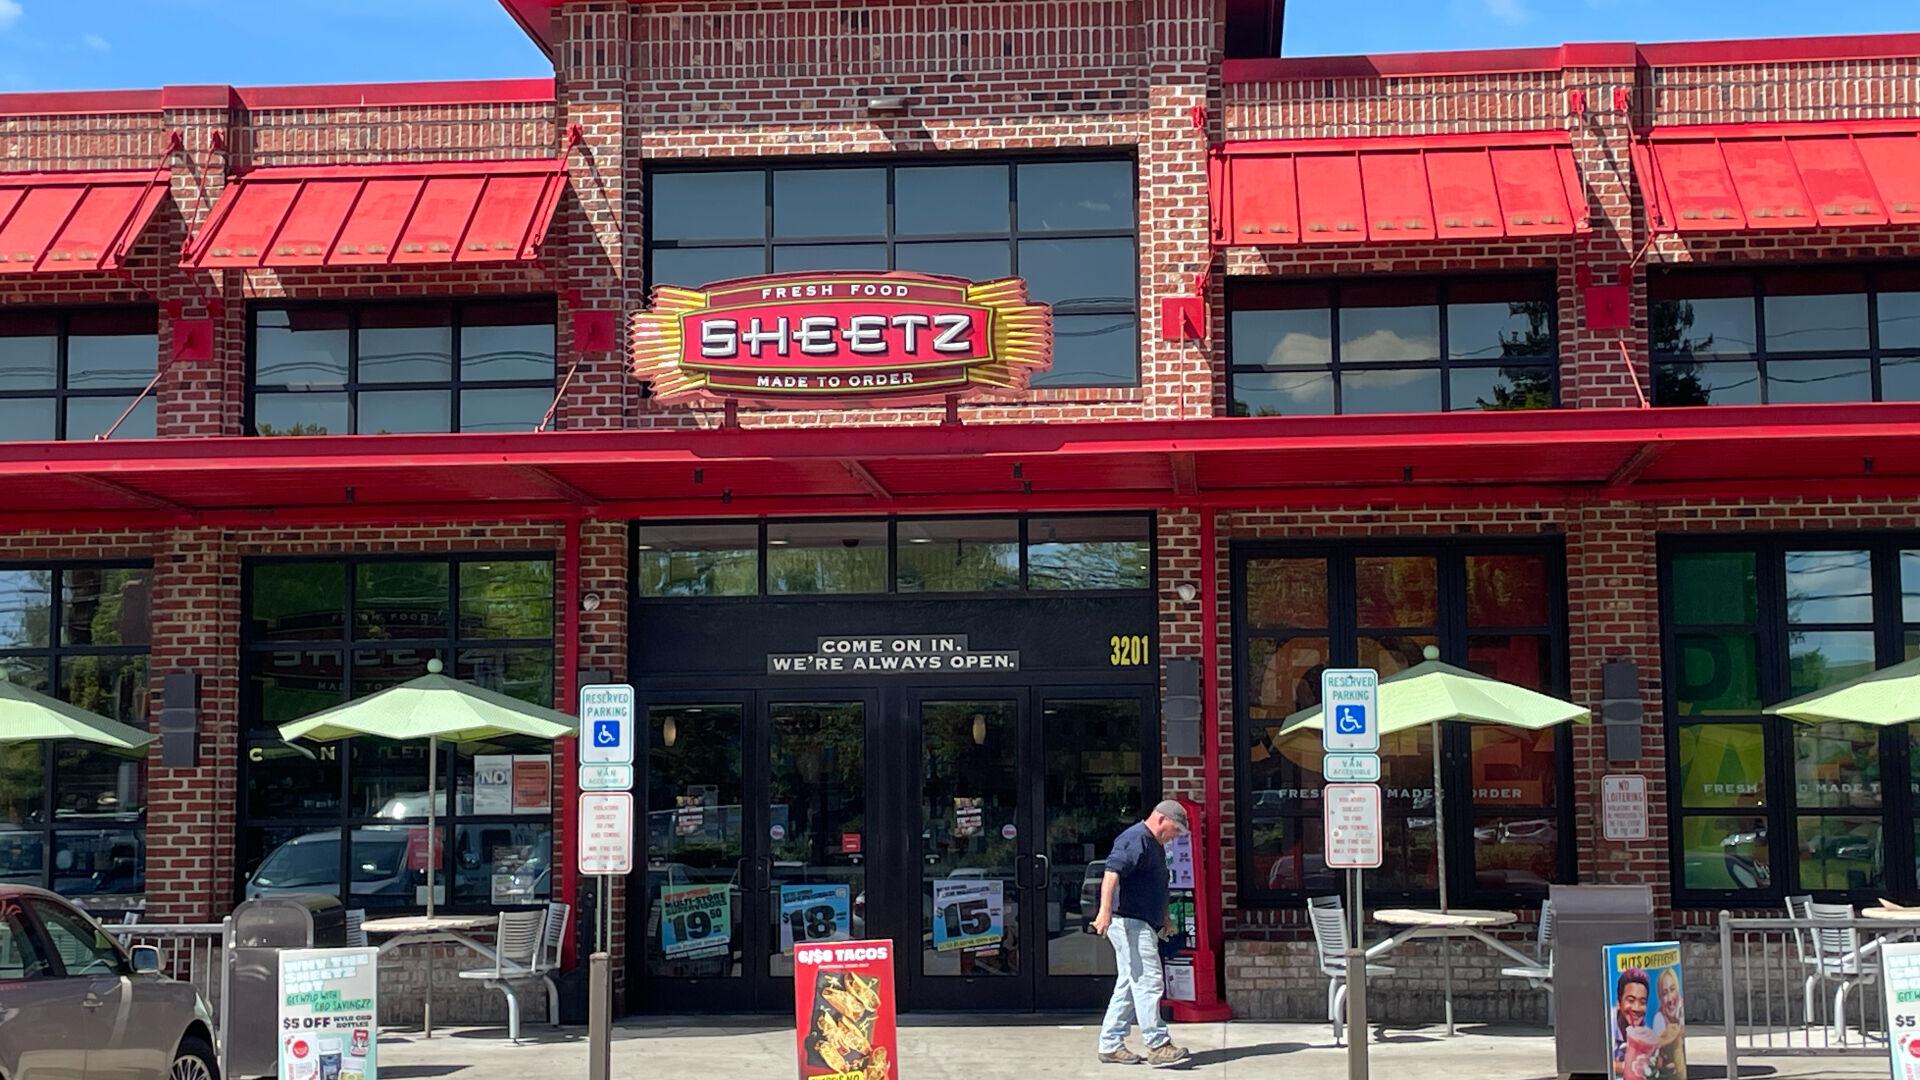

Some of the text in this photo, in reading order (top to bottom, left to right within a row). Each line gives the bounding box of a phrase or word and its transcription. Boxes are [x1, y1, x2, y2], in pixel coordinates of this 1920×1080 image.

[761, 284, 909, 299] FRESH FOOD
[702, 315, 970, 357] SHEETZ
[757, 372, 914, 388] MADE TO ORDER
[821, 638, 962, 654] COME ON IN.
[1110, 635, 1149, 666] 3201
[773, 654, 1015, 671] WE'RE ALWAYS OPEN.
[1328, 677, 1374, 687] RESERVED
[586, 693, 629, 704] RESERVED
[1332, 690, 1369, 700] PARKING
[587, 707, 627, 717] PARKING
[597, 769, 616, 777] VAN
[1618, 780, 1630, 791] NO
[1703, 783, 1758, 793] FRESH
[1816, 783, 1863, 793] MADE
[1387, 788, 1433, 798] MADE
[1606, 792, 1644, 803] LOITERING
[709, 908, 722, 919] 50
[936, 899, 991, 938] $15
[835, 947, 888, 961] TACOS
[1621, 950, 1678, 969] HITS DIFFERENT
[287, 996, 299, 1005] GET
[321, 990, 337, 999] WITH
[314, 1002, 330, 1011] CBD
[283, 1017, 300, 1029] $5
[303, 1017, 331, 1029] OFF
[1895, 1014, 1916, 1027] $5
